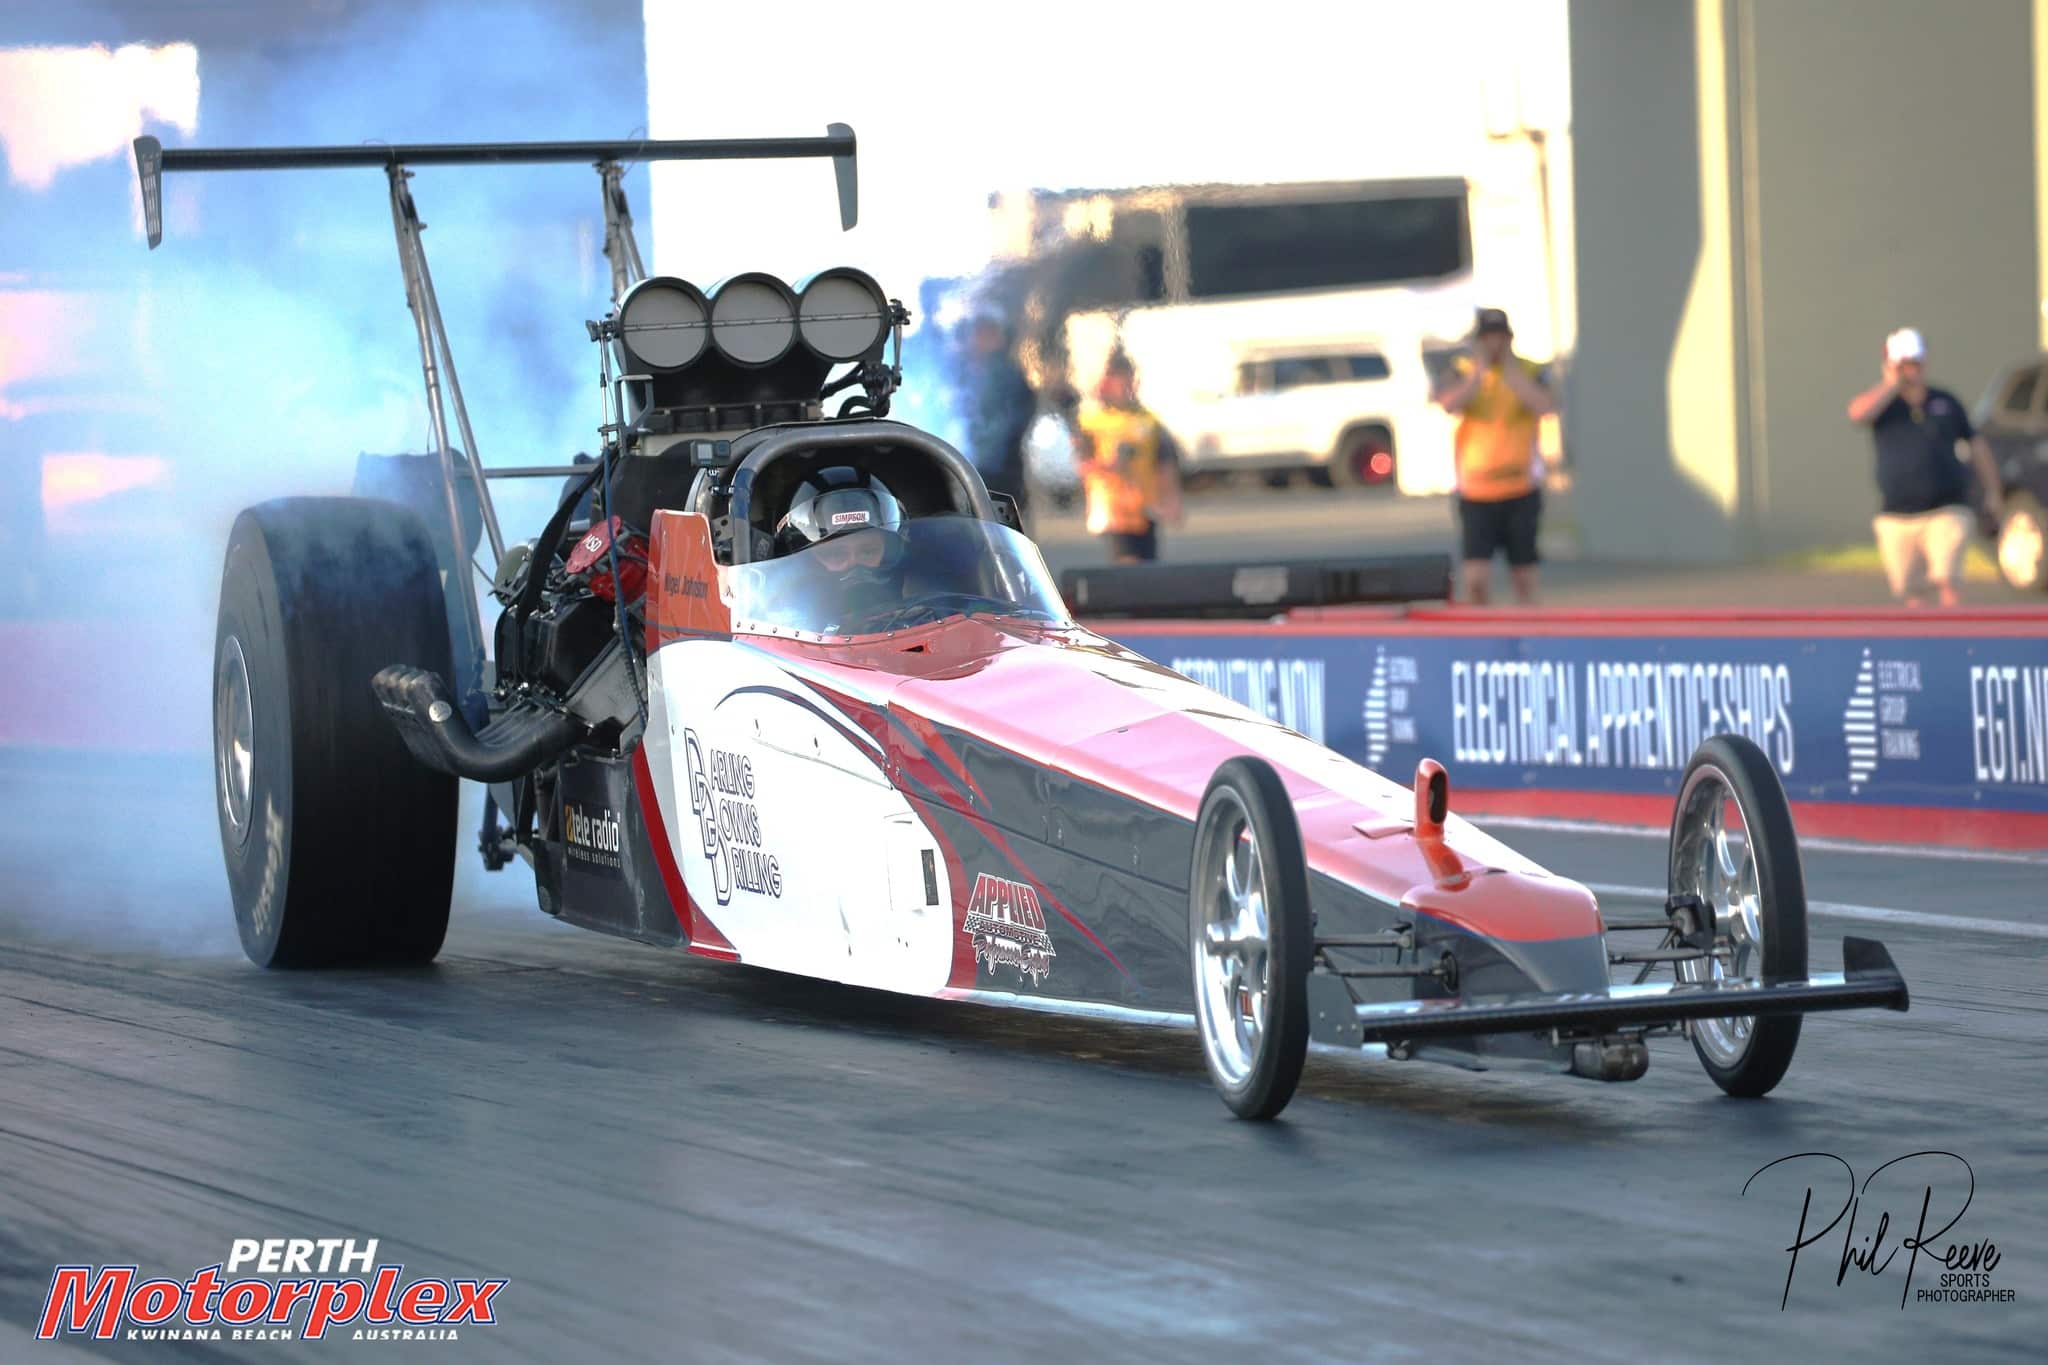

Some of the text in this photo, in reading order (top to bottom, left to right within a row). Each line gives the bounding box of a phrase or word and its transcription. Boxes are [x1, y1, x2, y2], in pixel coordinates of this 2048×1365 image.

[834, 512, 866, 523] SIMPSON
[582, 534, 602, 552] MSD
[1452, 660, 1582, 766] ELECTRICAL
[1586, 662, 1794, 774] APPRENTICESHIPS
[571, 804, 620, 853] tele radio
[968, 872, 1046, 933] APPLIED
[978, 919, 1041, 947] AUTOMOTIVE
